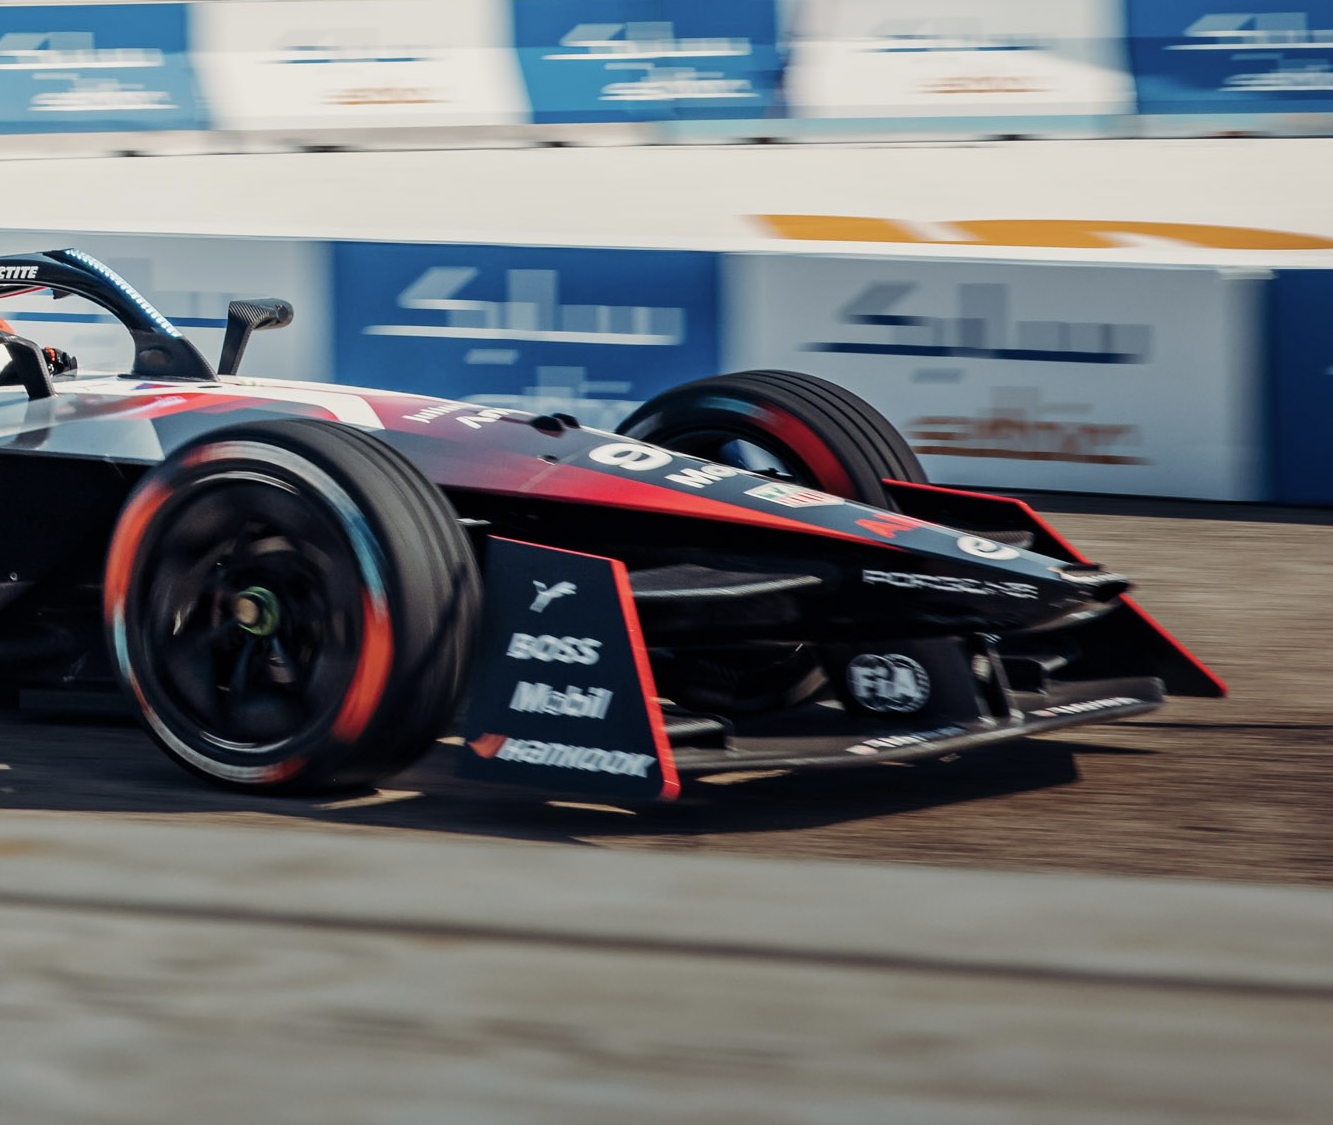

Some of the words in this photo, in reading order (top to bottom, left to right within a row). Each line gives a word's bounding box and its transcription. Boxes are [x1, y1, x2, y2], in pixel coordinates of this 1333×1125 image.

[862, 569, 1039, 600] PORSCHE
[506, 632, 603, 665] BOSS
[509, 681, 614, 720] Mobil
